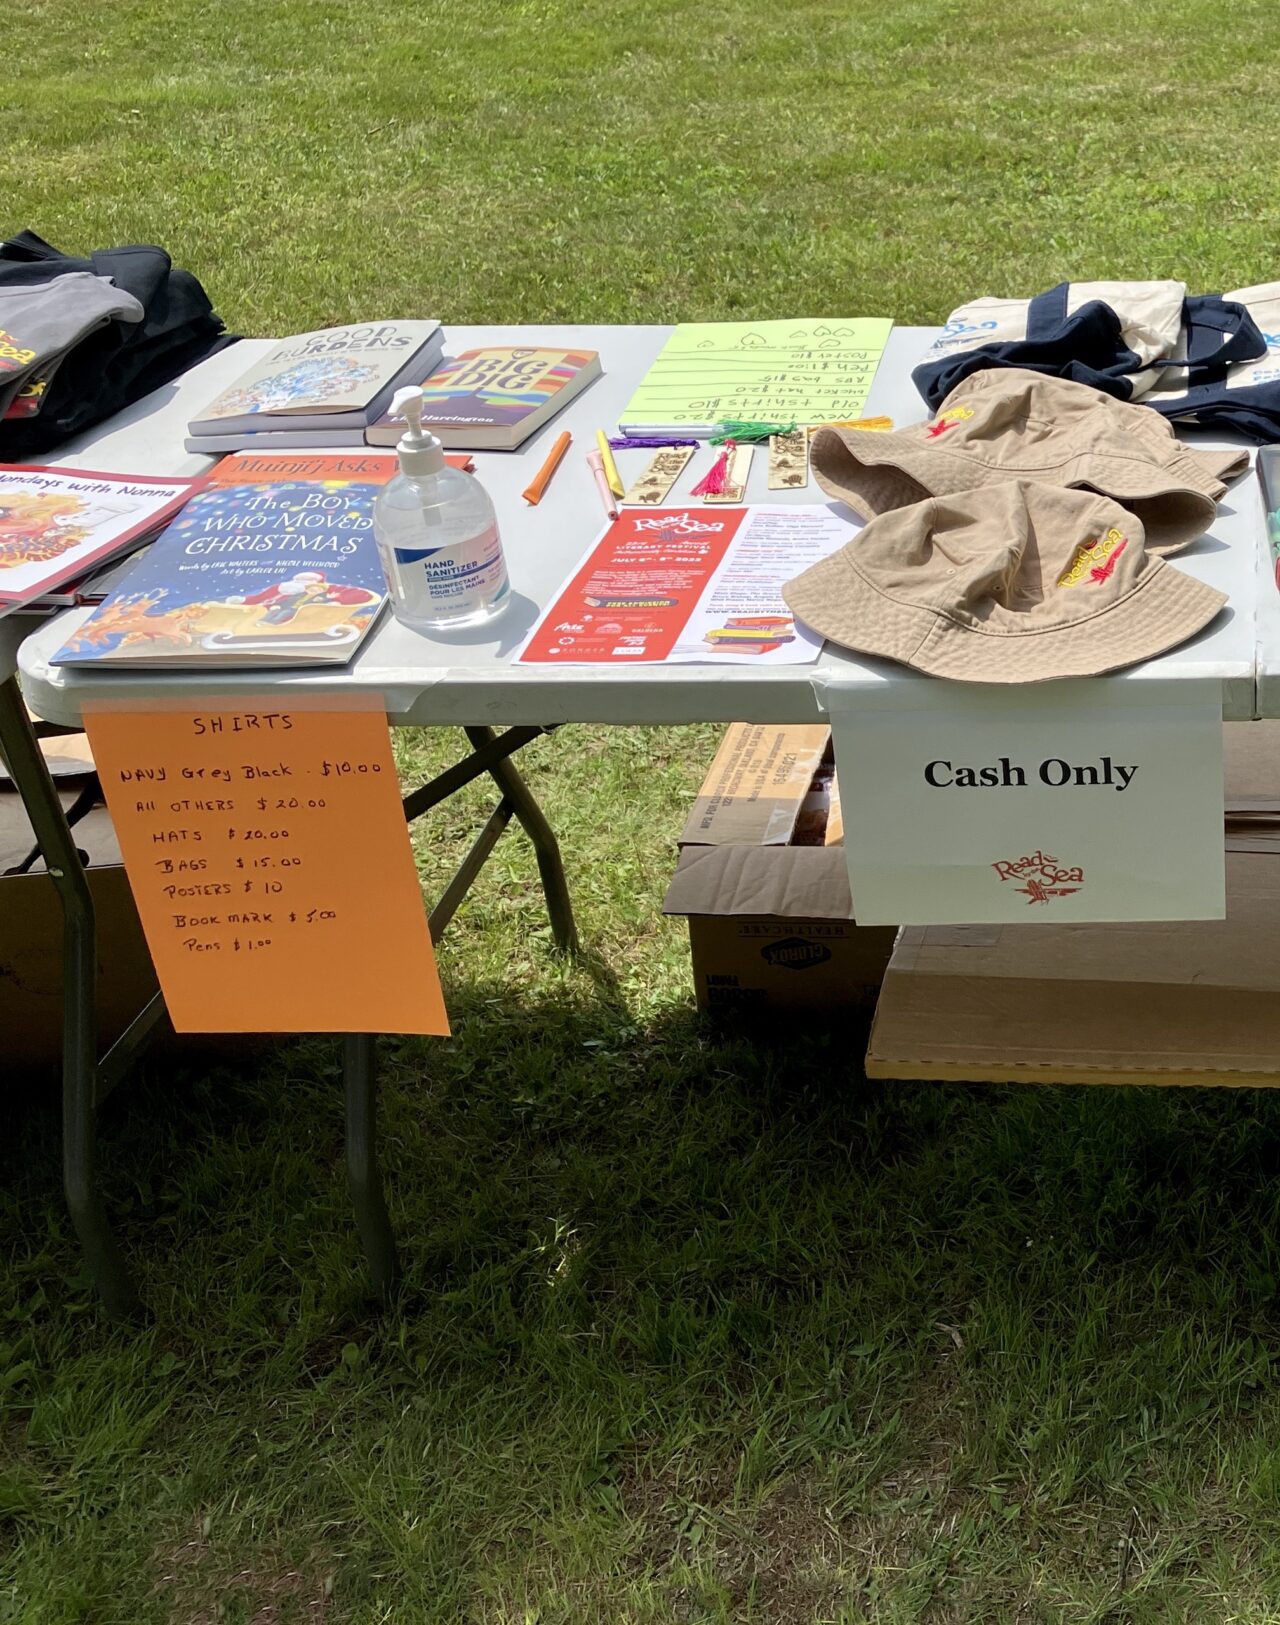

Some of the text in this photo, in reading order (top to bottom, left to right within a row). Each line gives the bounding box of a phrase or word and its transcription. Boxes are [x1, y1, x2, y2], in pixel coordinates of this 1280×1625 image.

[305, 327, 397, 346] GOOD
[271, 336, 412, 360] BURDENS
[466, 358, 548, 375] BIG
[447, 372, 533, 390] DIG
[736, 384, 768, 393] $20
[688, 398, 723, 408] $10
[673, 410, 716, 420] $20
[327, 459, 385, 472] Asks
[67, 482, 112, 494] with
[117, 486, 176, 498] Nonna
[244, 493, 360, 511] The BOY
[202, 511, 373, 531] WHO MOVED
[632, 512, 689, 531] Read
[673, 519, 725, 534] Sea
[184, 534, 364, 555] CHRISTMAS
[424, 559, 455, 570] HAND
[426, 561, 478, 578] SANITIZER
[428, 575, 480, 591] DÉSINFECTANT
[430, 588, 452, 596] POUR
[465, 579, 486, 590] MAINS
[193, 713, 294, 736] SHIRTS
[120, 766, 168, 783] NAVY
[241, 762, 293, 780] Black
[924, 756, 1140, 792] Cash Only
[170, 799, 235, 813] OTHERS
[153, 829, 203, 844] HATS
[154, 857, 209, 875] BAGS
[991, 850, 1045, 882] Read
[1039, 864, 1085, 887] Sea
[162, 882, 233, 900] POSTERS
[264, 880, 285, 895] 10
